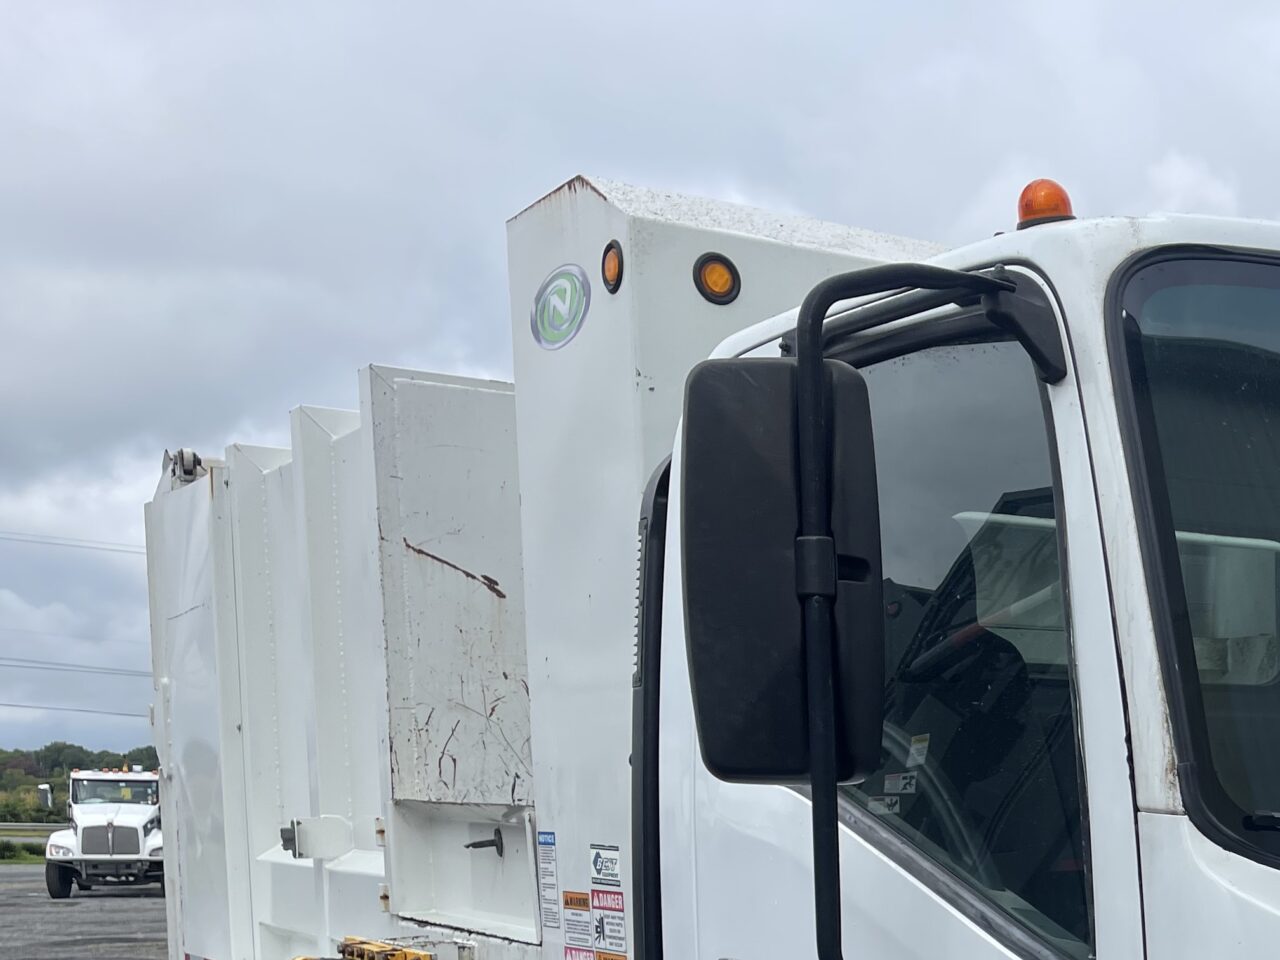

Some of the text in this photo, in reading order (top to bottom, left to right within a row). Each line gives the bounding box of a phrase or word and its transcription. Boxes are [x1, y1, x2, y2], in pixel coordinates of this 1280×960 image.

[539, 834, 554, 844] NOTICE
[596, 858, 618, 871] BEST
[569, 896, 588, 908] WARNING
[599, 892, 623, 909] DANGER
